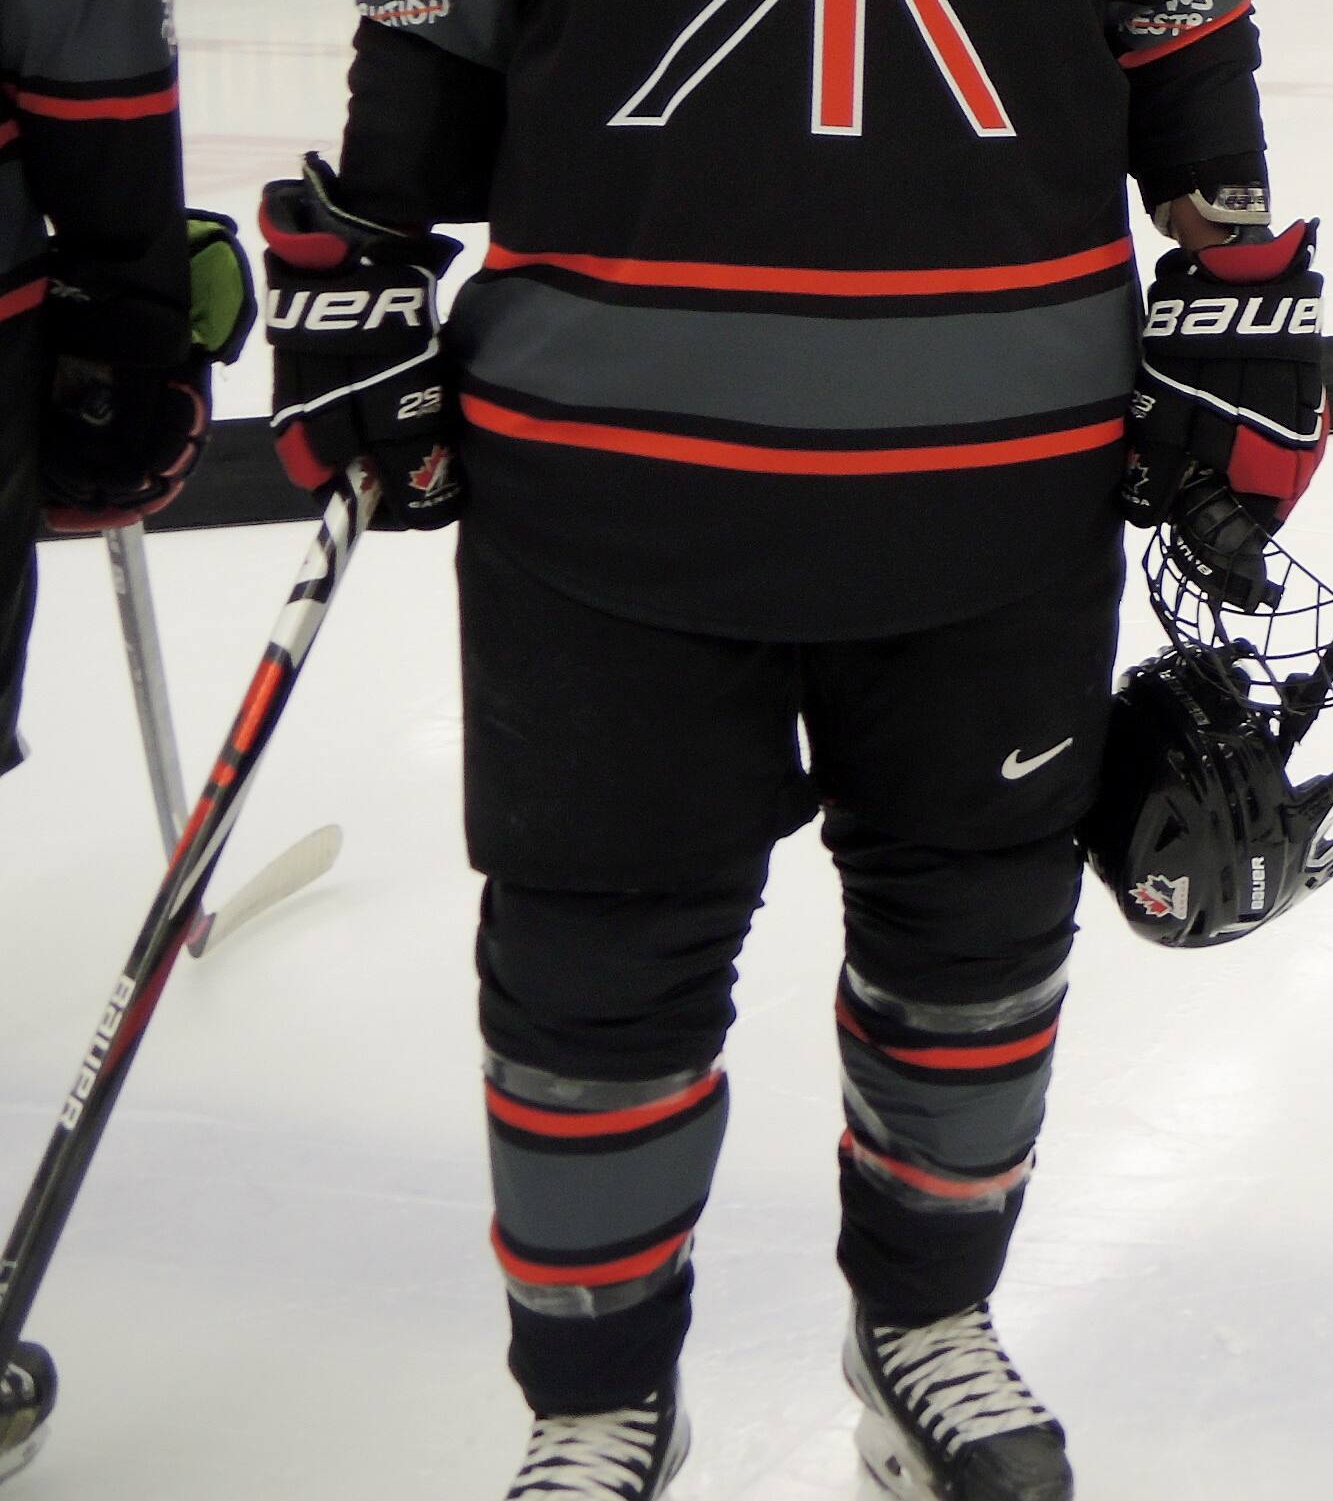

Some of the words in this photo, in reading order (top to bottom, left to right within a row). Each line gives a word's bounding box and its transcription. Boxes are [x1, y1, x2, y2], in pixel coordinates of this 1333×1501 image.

[1144, 297, 1321, 337] BAUE
[1250, 856, 1266, 910] BAUER
[58, 974, 137, 1131] BAUER
